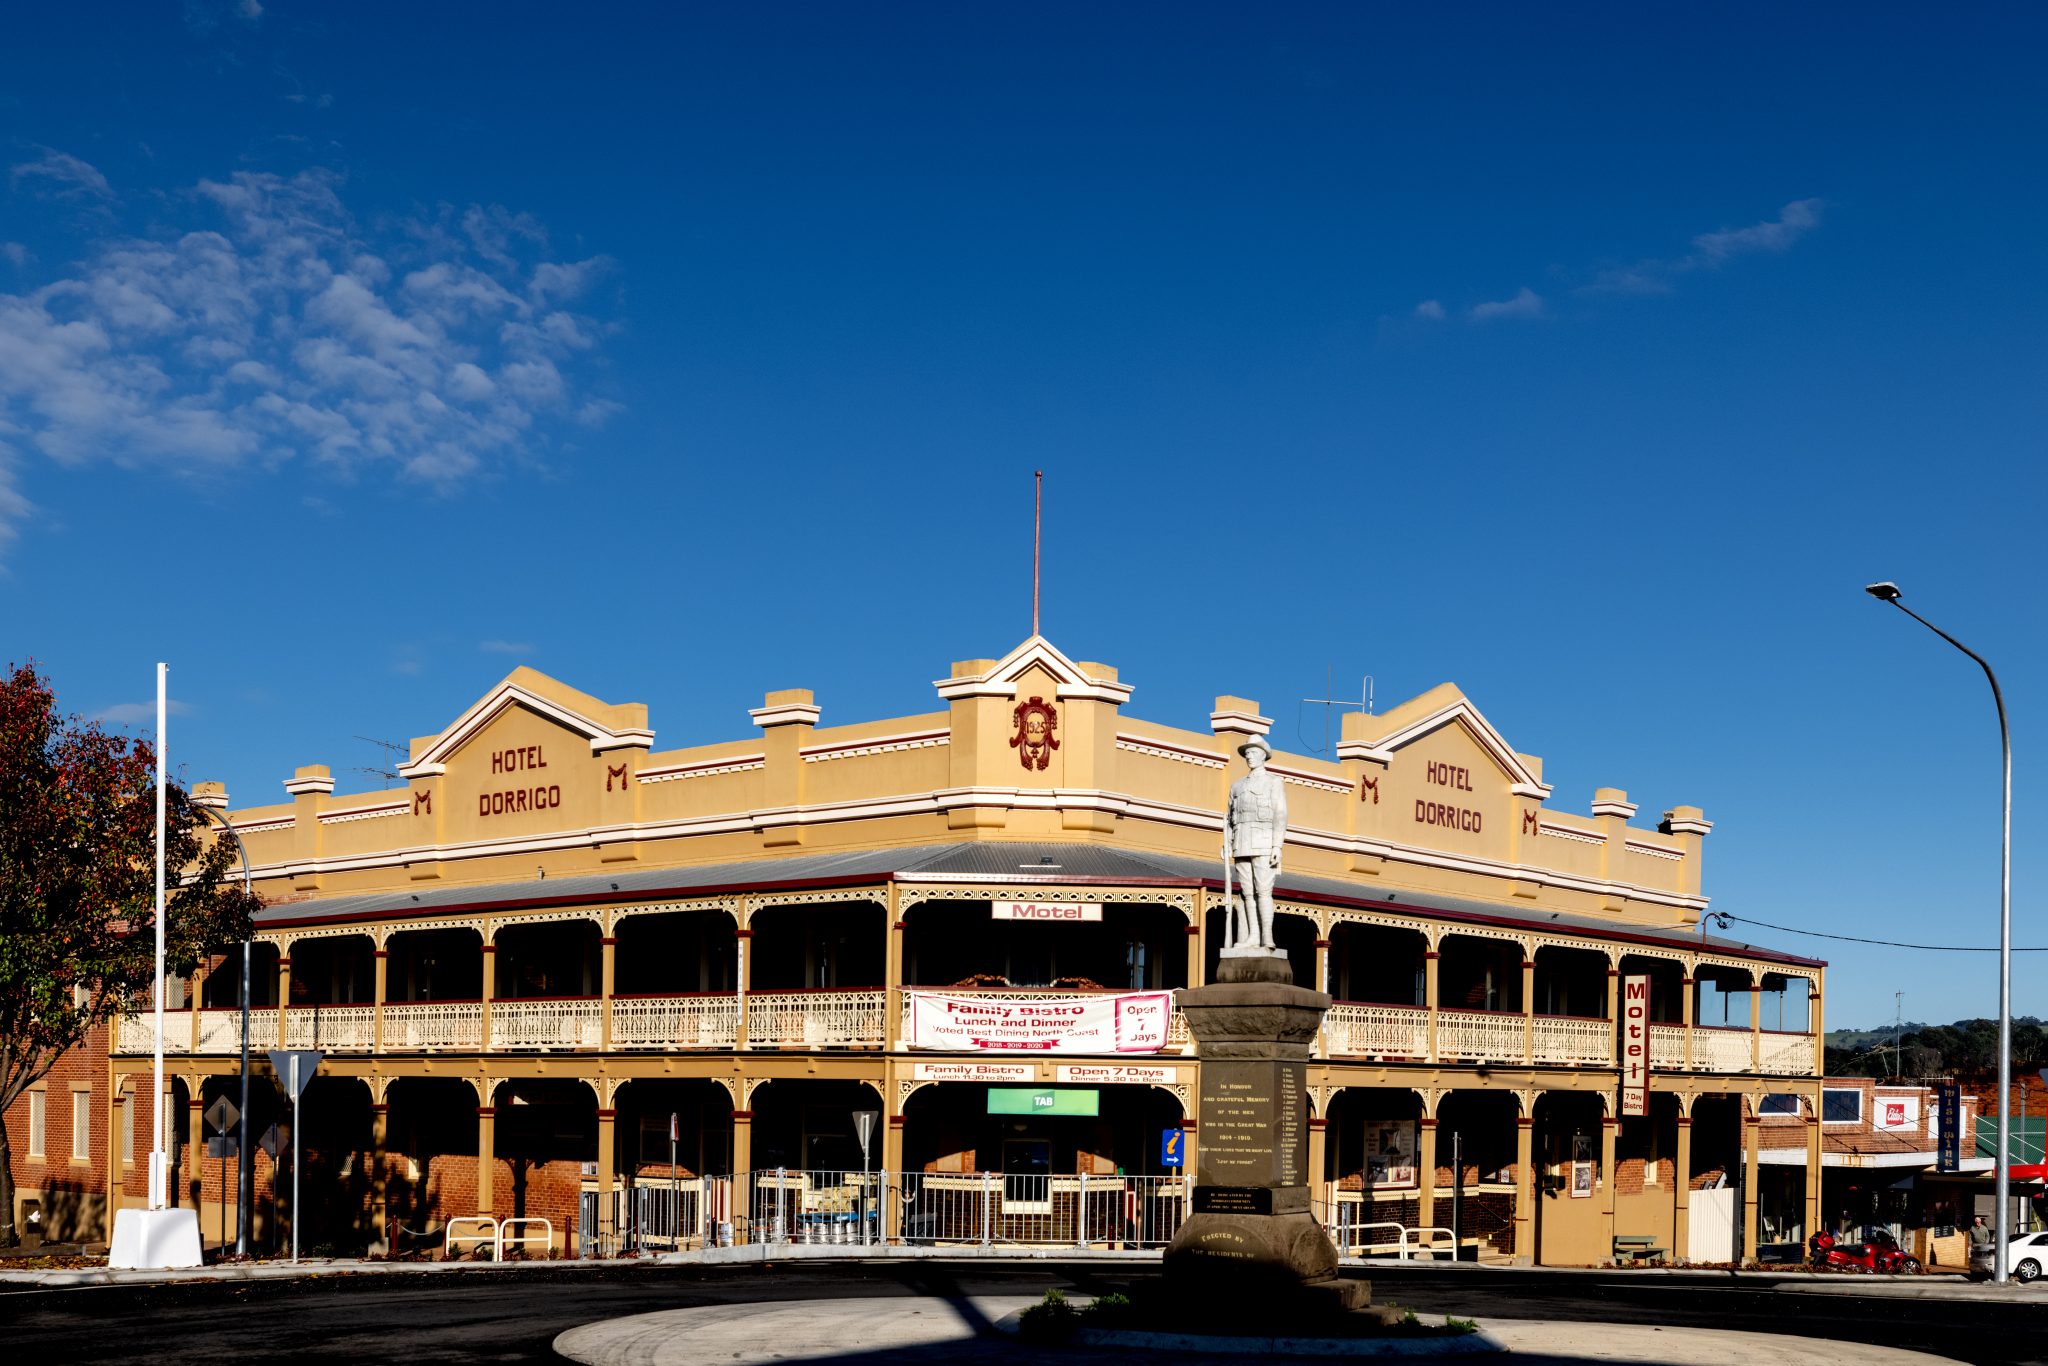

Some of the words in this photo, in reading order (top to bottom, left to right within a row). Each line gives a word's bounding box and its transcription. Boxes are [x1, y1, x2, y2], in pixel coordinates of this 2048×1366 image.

[492, 745, 547, 774] HOTEL
[1427, 760, 1473, 792] HOTEL
[480, 785, 560, 816] DORRIGO
[1415, 799, 1482, 834] DORRIGO
[1012, 904, 1082, 918] Motel
[948, 1002, 1012, 1018] Family
[1020, 1006, 1084, 1016] Bistro
[955, 1016, 996, 1026] Lunch
[1000, 1018, 1026, 1026] and
[932, 1026, 964, 1034] Voted
[996, 1030, 1029, 1038] Dining
[1066, 1028, 1099, 1036] Coast
[1627, 983, 1644, 1078] Motel
[924, 1065, 972, 1074] Family
[976, 1066, 1024, 1074] Bistro
[1070, 1067, 1109, 1076] Open
[1126, 1068, 1164, 1077] Days
[1034, 1096, 1053, 1105] TAB
[1630, 1094, 1642, 1102] Day
[1202, 1232, 1232, 1242] ERECTED
[1234, 1235, 1244, 1243] BY
